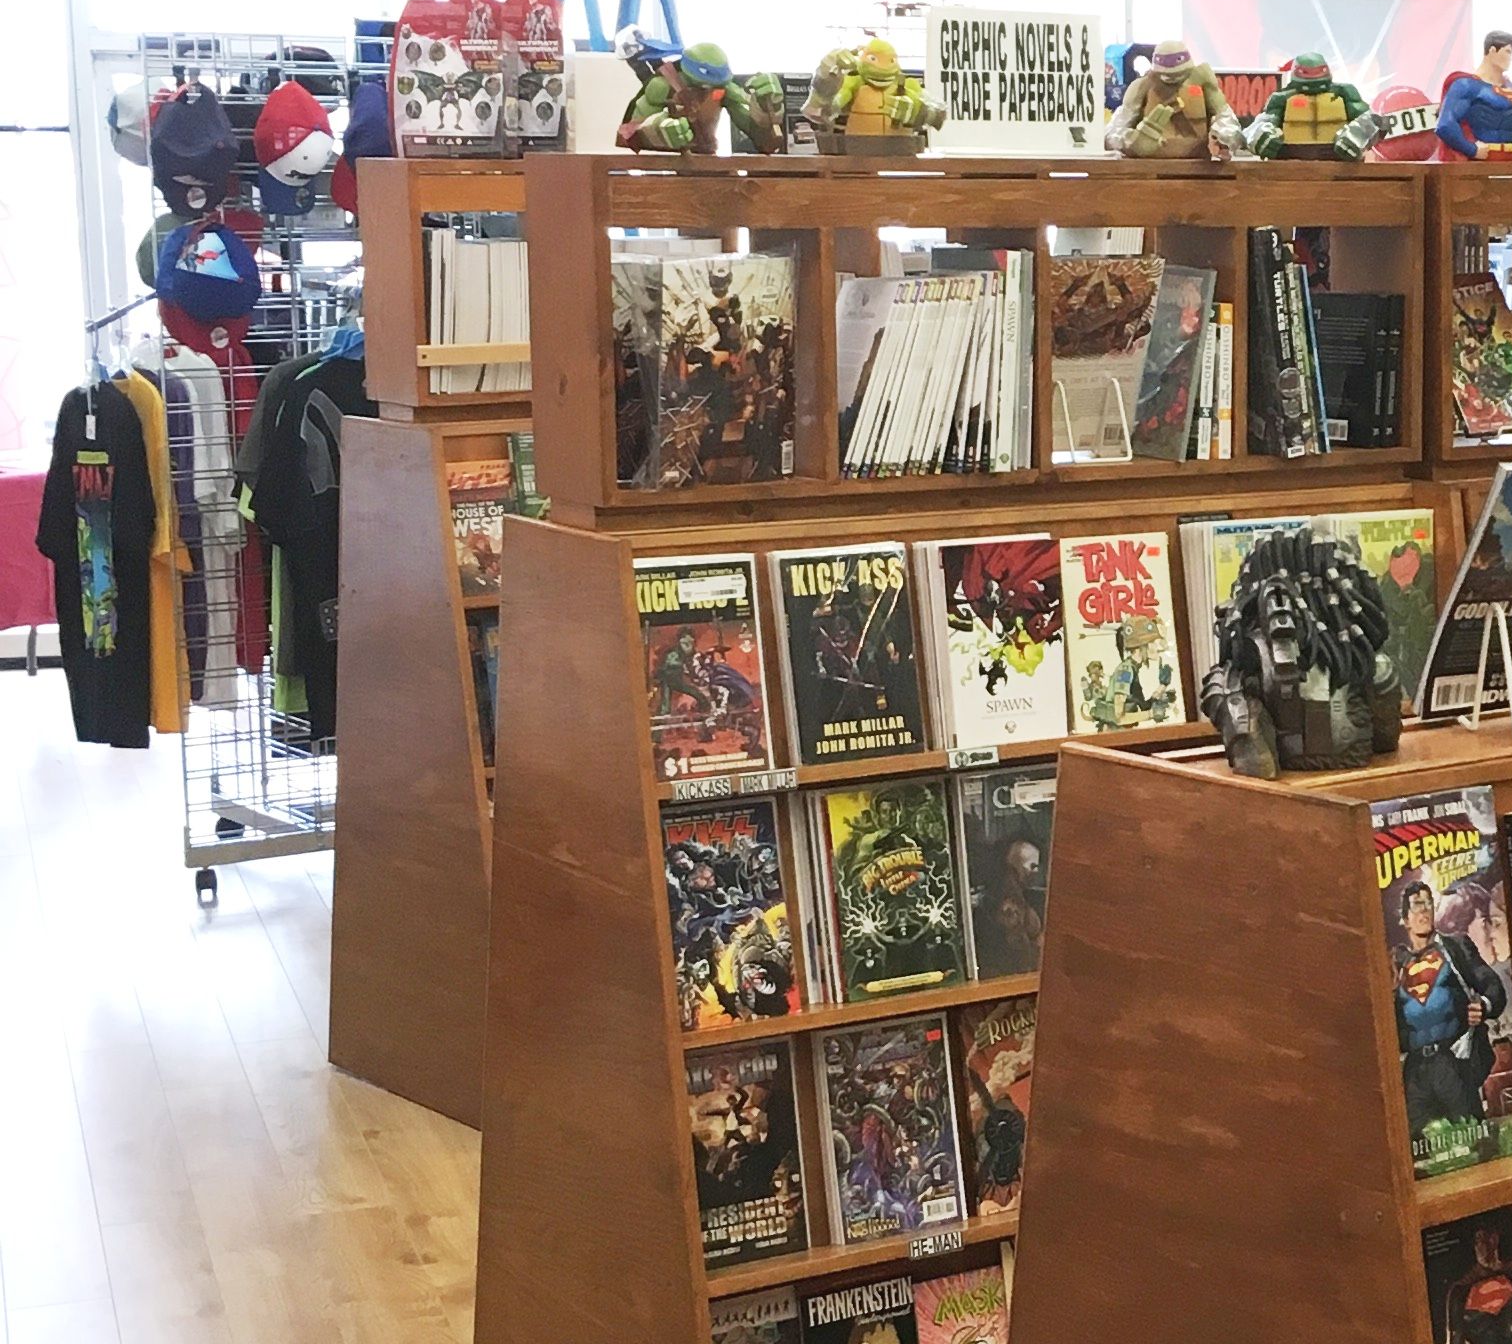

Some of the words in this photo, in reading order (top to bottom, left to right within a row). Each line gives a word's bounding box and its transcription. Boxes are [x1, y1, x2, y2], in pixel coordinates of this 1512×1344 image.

[940, 19, 1007, 71] GRAPHIC
[1015, 22, 1072, 73] NOVELS
[1080, 25, 1091, 72] &
[940, 71, 991, 121] TRADE
[1000, 73, 1095, 123] PAPERBACKS
[1453, 282, 1494, 300] STICE
[453, 516, 503, 541] WEST
[1076, 540, 1152, 583] TANK
[790, 561, 848, 597] KICK
[858, 557, 904, 589] ASS
[986, 698, 1033, 713] SPAWN
[824, 719, 857, 736] MARK
[862, 715, 904, 733] MILLAR
[816, 738, 846, 755] JOHN
[849, 734, 895, 751] ROMITA
[900, 731, 915, 746] JR.
[664, 757, 689, 777] $1
[676, 780, 730, 800] KICK-ASS
[665, 816, 758, 853] KISS
[878, 849, 925, 873] TROUBLE
[1376, 830, 1480, 889] UPERMAN
[728, 1216, 788, 1244] WORLD
[910, 1233, 963, 1257] HE-MAN
[807, 1276, 914, 1327] FRANKENSTEIN
